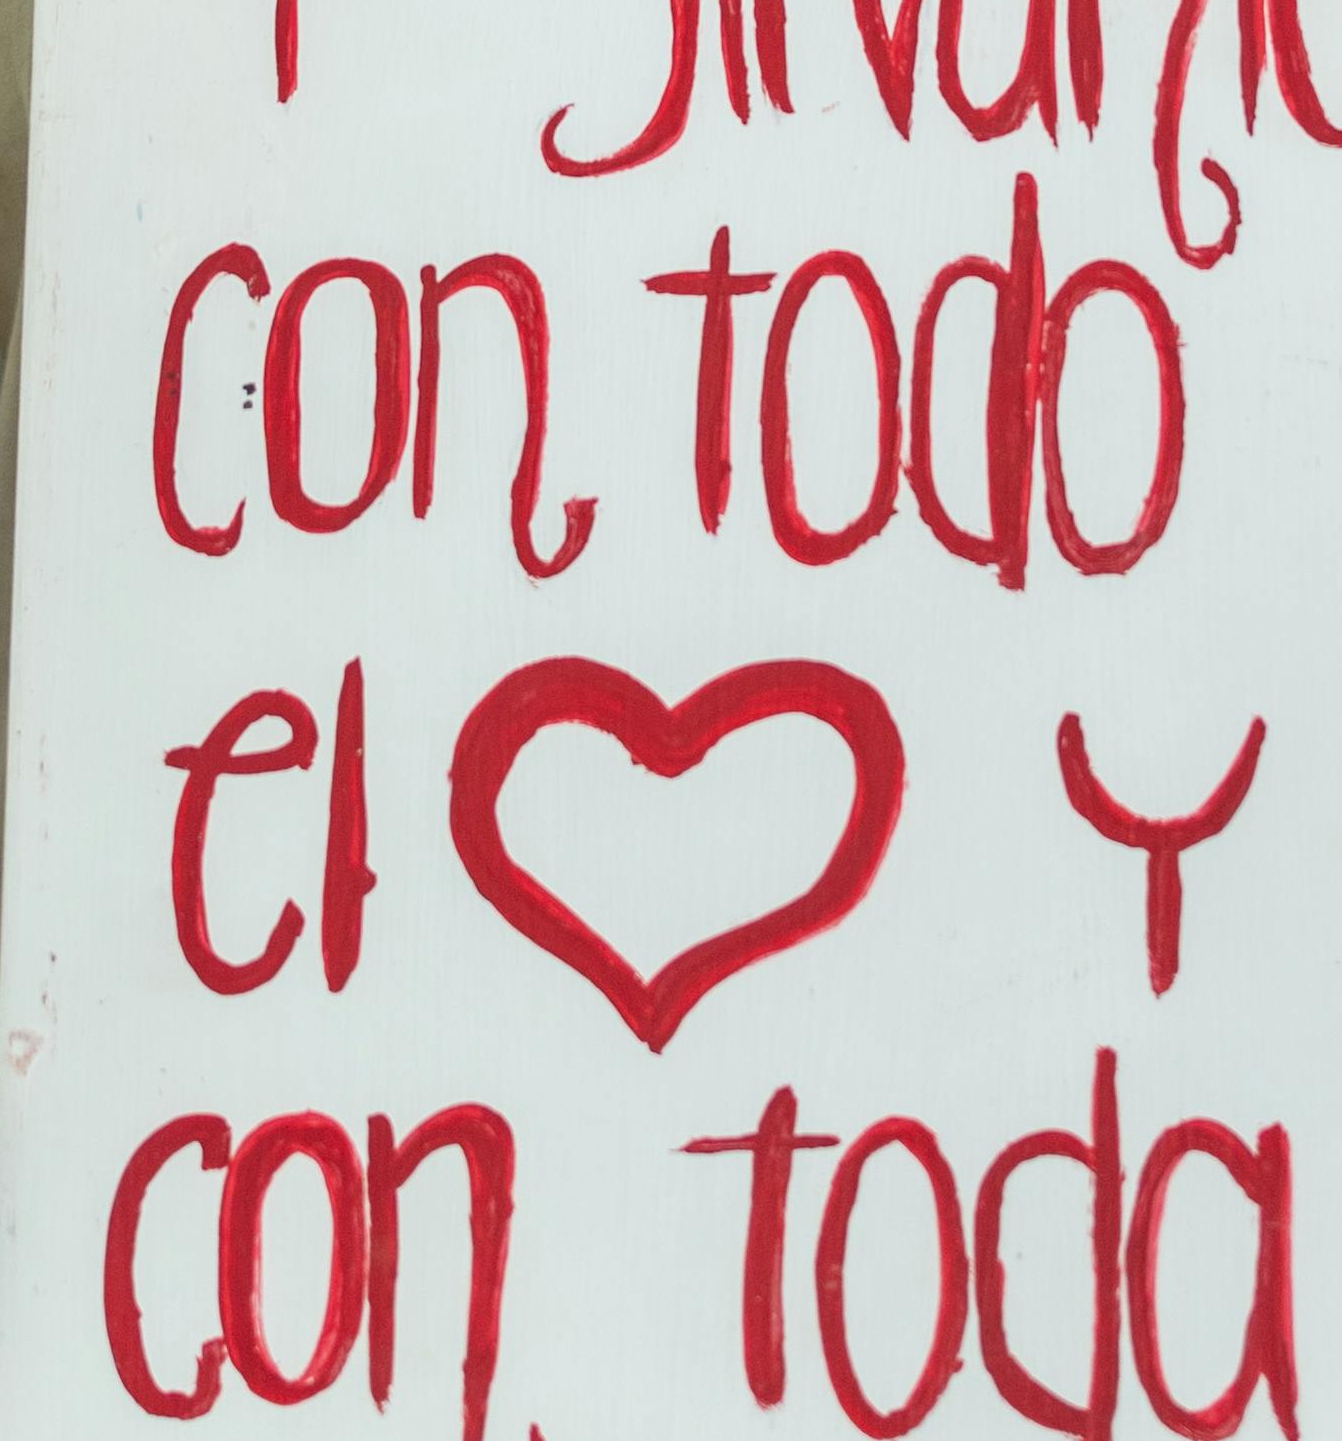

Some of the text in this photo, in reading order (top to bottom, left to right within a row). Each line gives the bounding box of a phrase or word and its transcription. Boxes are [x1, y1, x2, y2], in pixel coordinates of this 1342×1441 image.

[152, 171, 1186, 592] con todo
[164, 658, 377, 996] el
